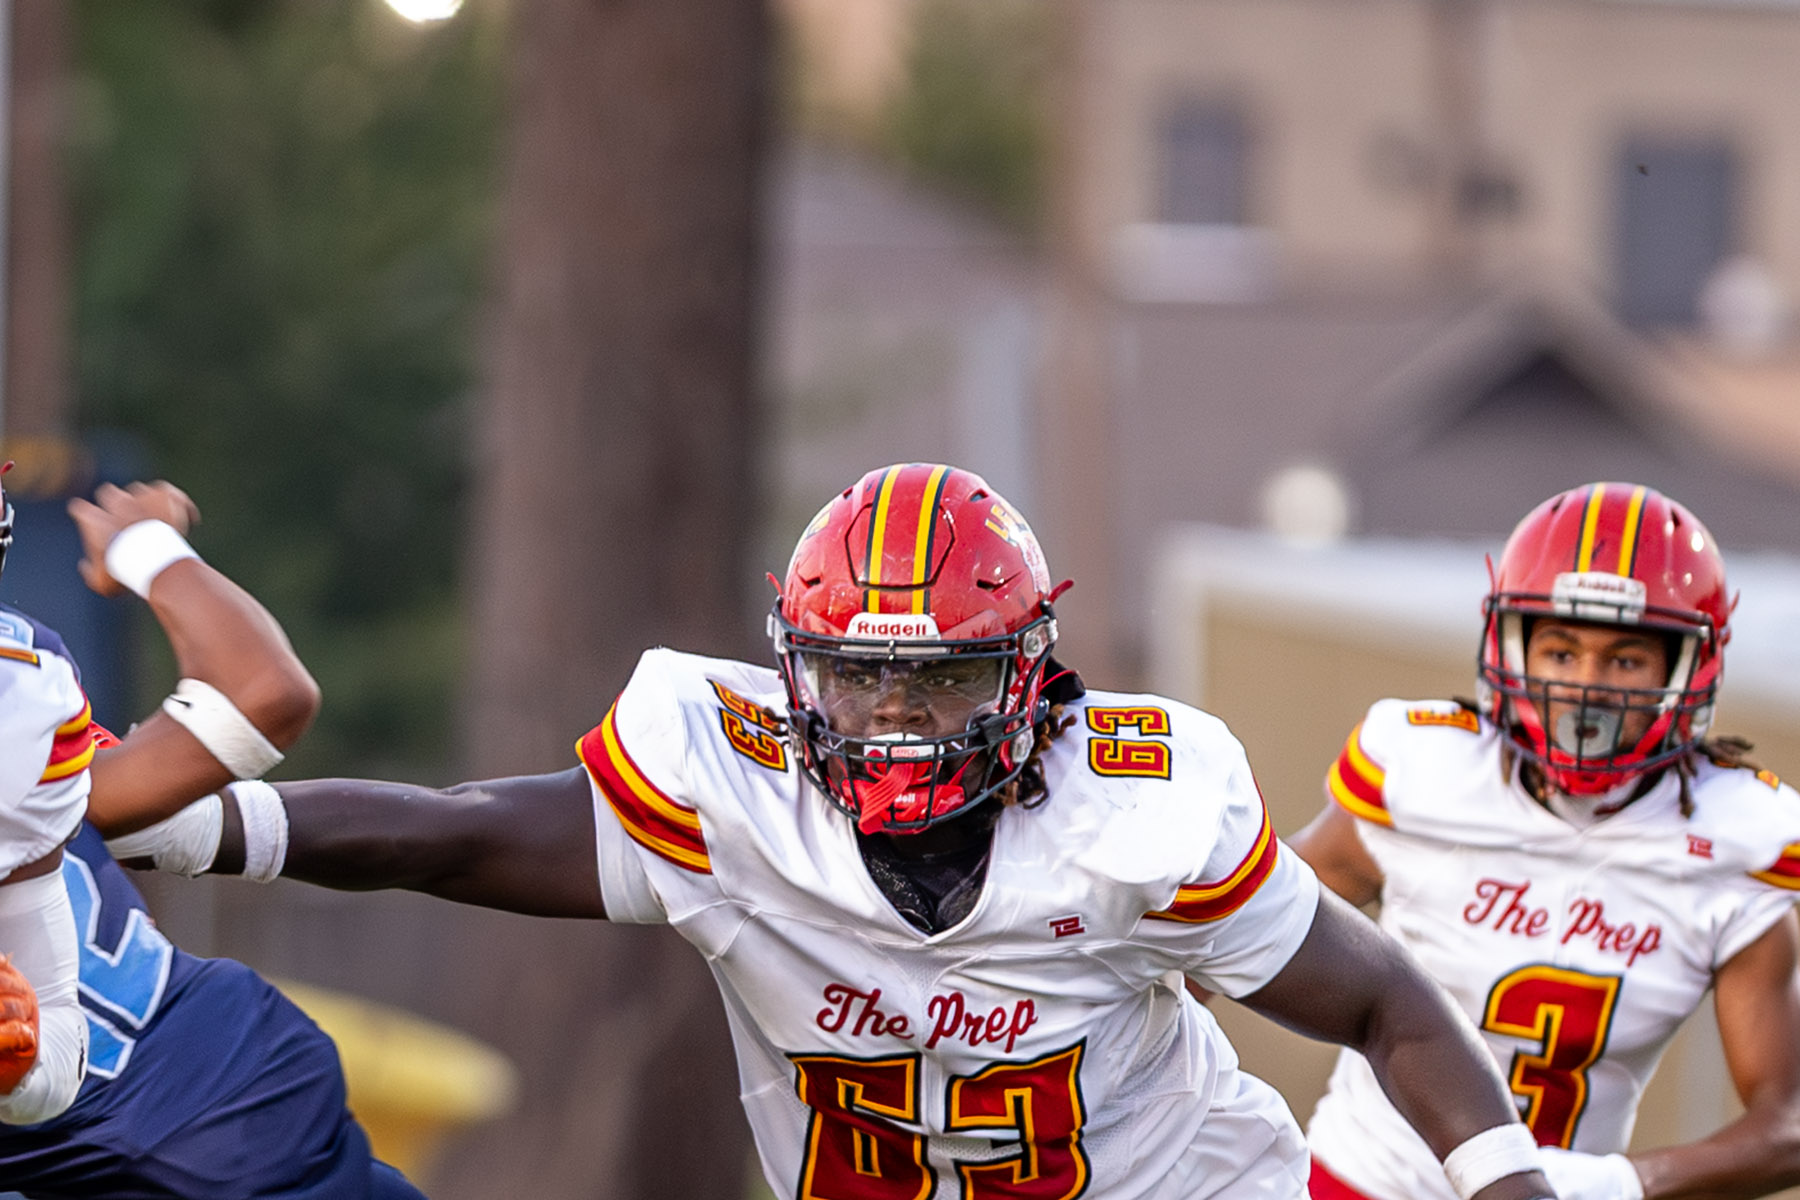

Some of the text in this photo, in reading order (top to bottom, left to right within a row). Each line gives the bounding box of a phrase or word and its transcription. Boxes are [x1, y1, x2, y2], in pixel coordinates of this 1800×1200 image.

[856, 620, 928, 637] Riddell
[1085, 705, 1172, 781] 63
[1463, 879, 1664, 968] The Prep
[815, 983, 1039, 1054] The Prep
[1483, 963, 1623, 1152] 3
